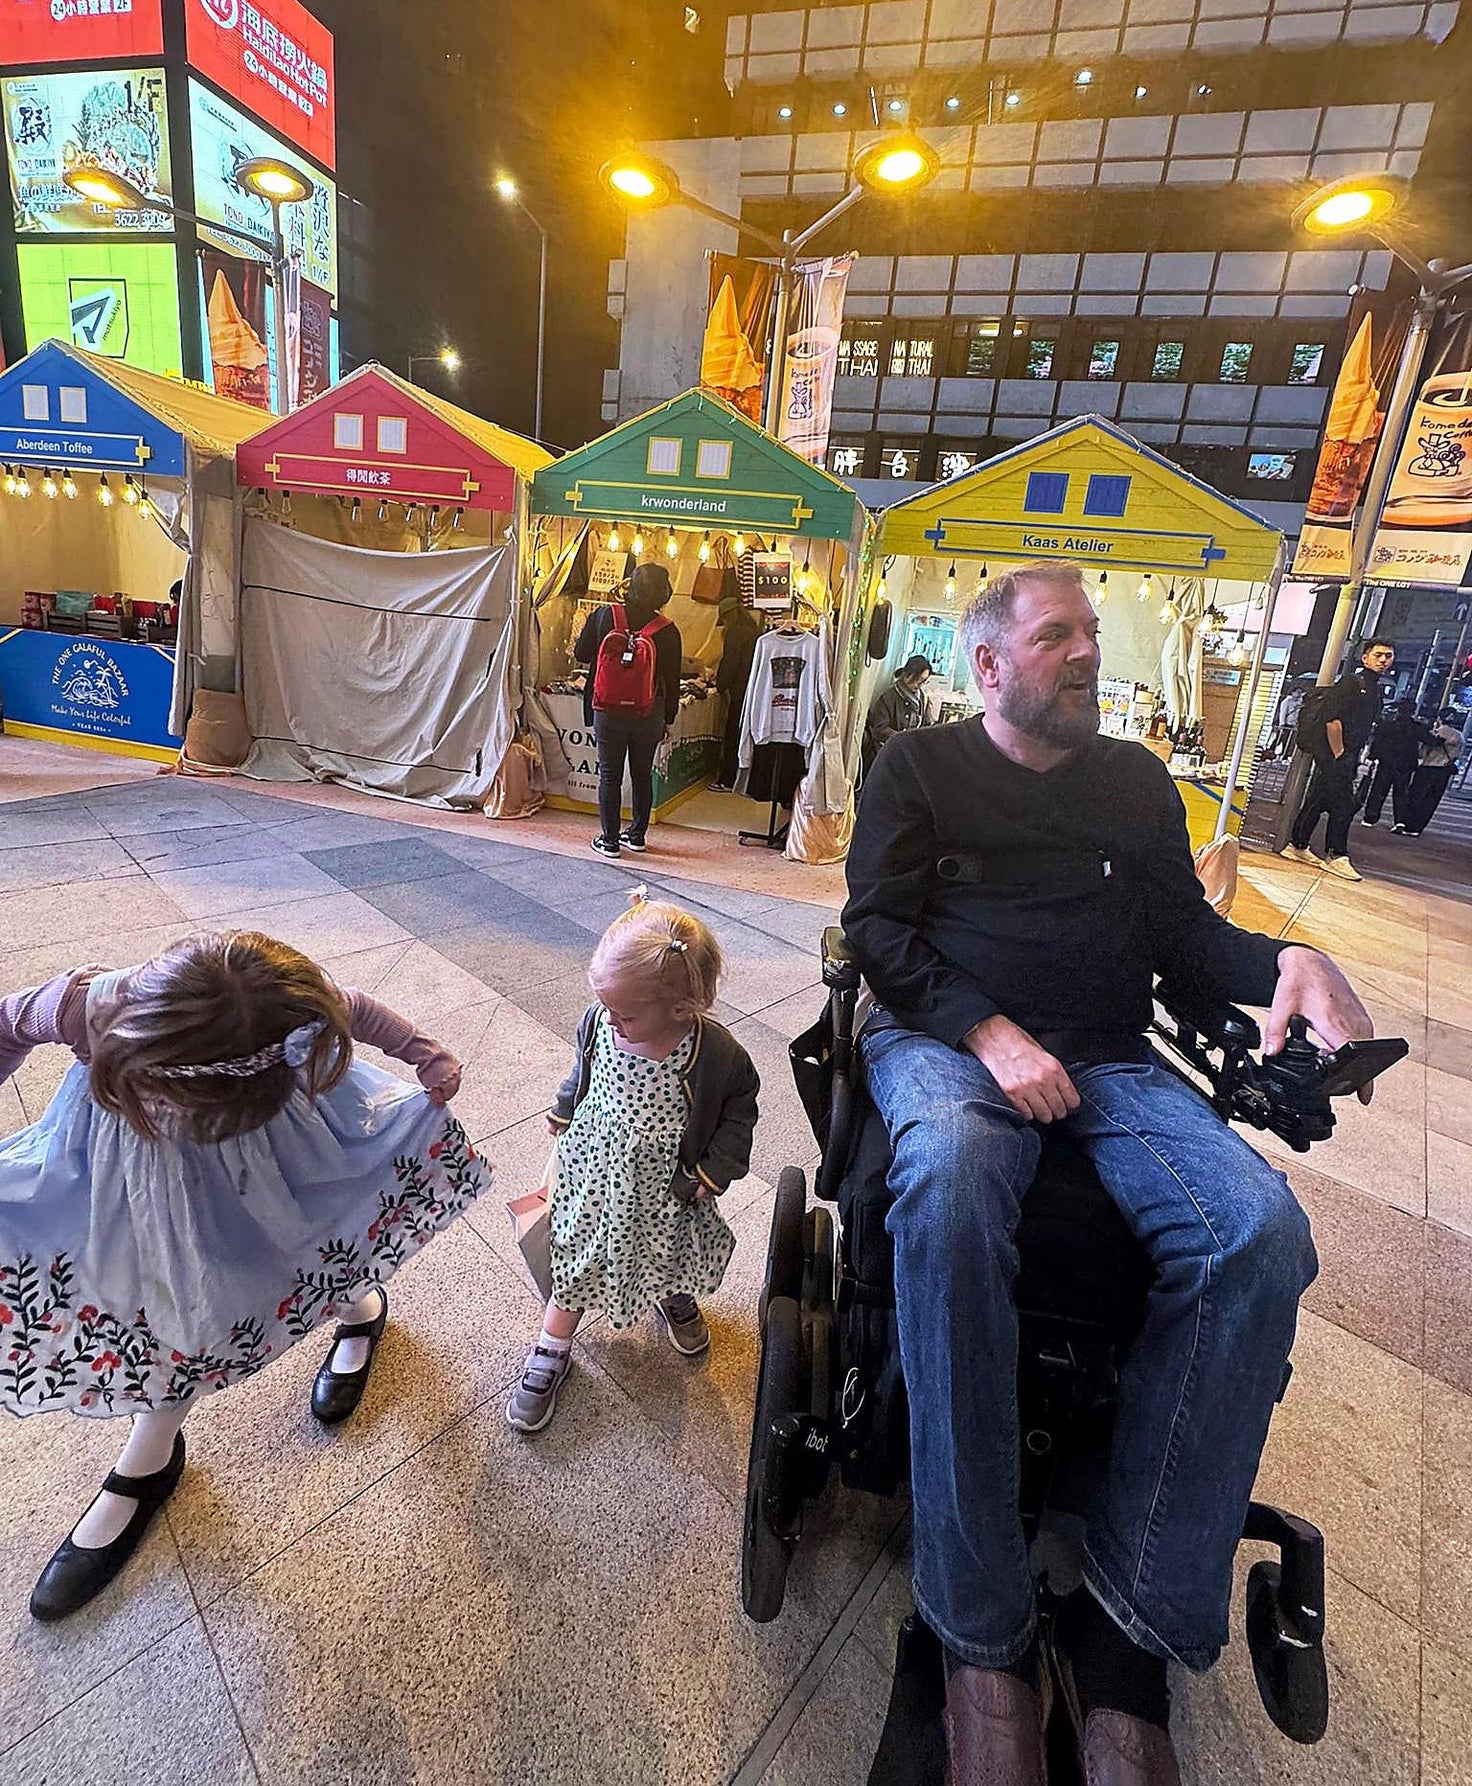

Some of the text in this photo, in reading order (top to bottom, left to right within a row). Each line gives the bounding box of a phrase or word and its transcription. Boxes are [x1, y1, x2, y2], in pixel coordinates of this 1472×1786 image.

[124, 76, 162, 112] 1/F
[310, 82, 327, 108] Pot
[16, 438, 93, 454] Aberdeen Toffee
[641, 494, 727, 513] krwonderland
[1022, 534, 1114, 553] Kaas Atelier
[758, 576, 788, 585] $100
[52, 666, 62, 685] THE
[58, 648, 72, 665] ONE
[107, 658, 129, 696] BAZAAR
[86, 709, 100, 722] Life
[805, 1427, 829, 1453] ibot
